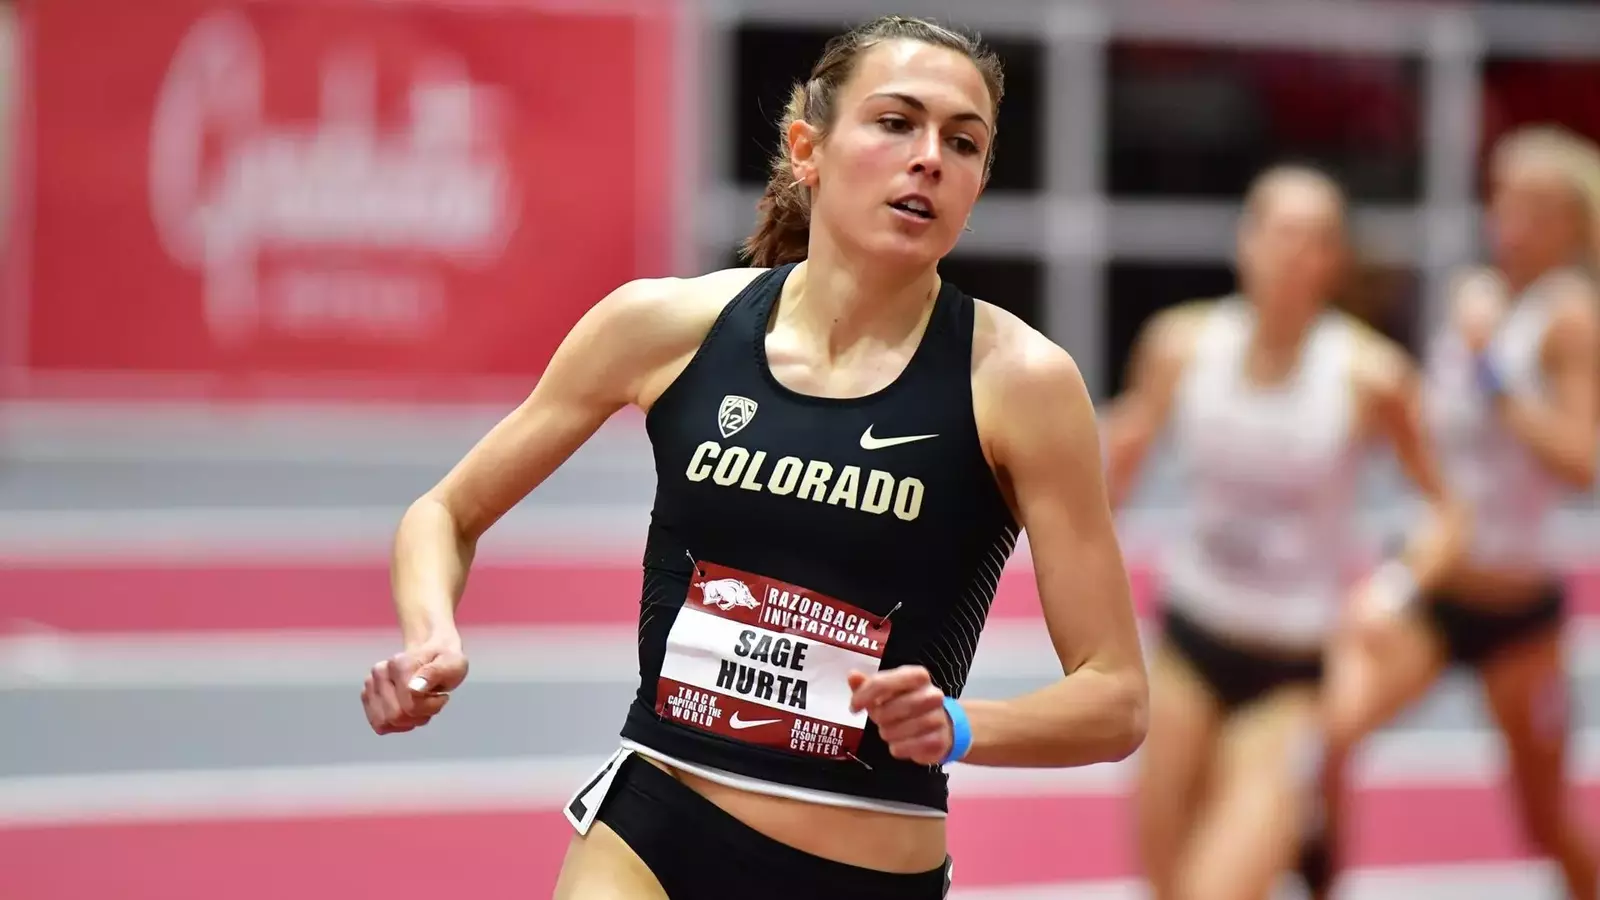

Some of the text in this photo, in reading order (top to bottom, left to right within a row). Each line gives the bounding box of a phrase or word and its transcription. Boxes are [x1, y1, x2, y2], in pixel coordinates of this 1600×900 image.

[721, 398, 755, 424] PAC
[722, 413, 742, 430] 12
[686, 441, 925, 521] COLORADO
[768, 587, 869, 635] RAZORBACK
[764, 607, 878, 651] INVITATIONAL
[734, 630, 809, 671] SAGE
[679, 686, 717, 706] TRACK
[716, 659, 808, 710] HURTA
[668, 695, 722, 719] CAPITAL OF THE
[672, 705, 713, 727] WORLD
[791, 728, 843, 746] TYSON TRACK
[793, 718, 844, 739] RANDAL
[790, 738, 839, 755] CENTER
